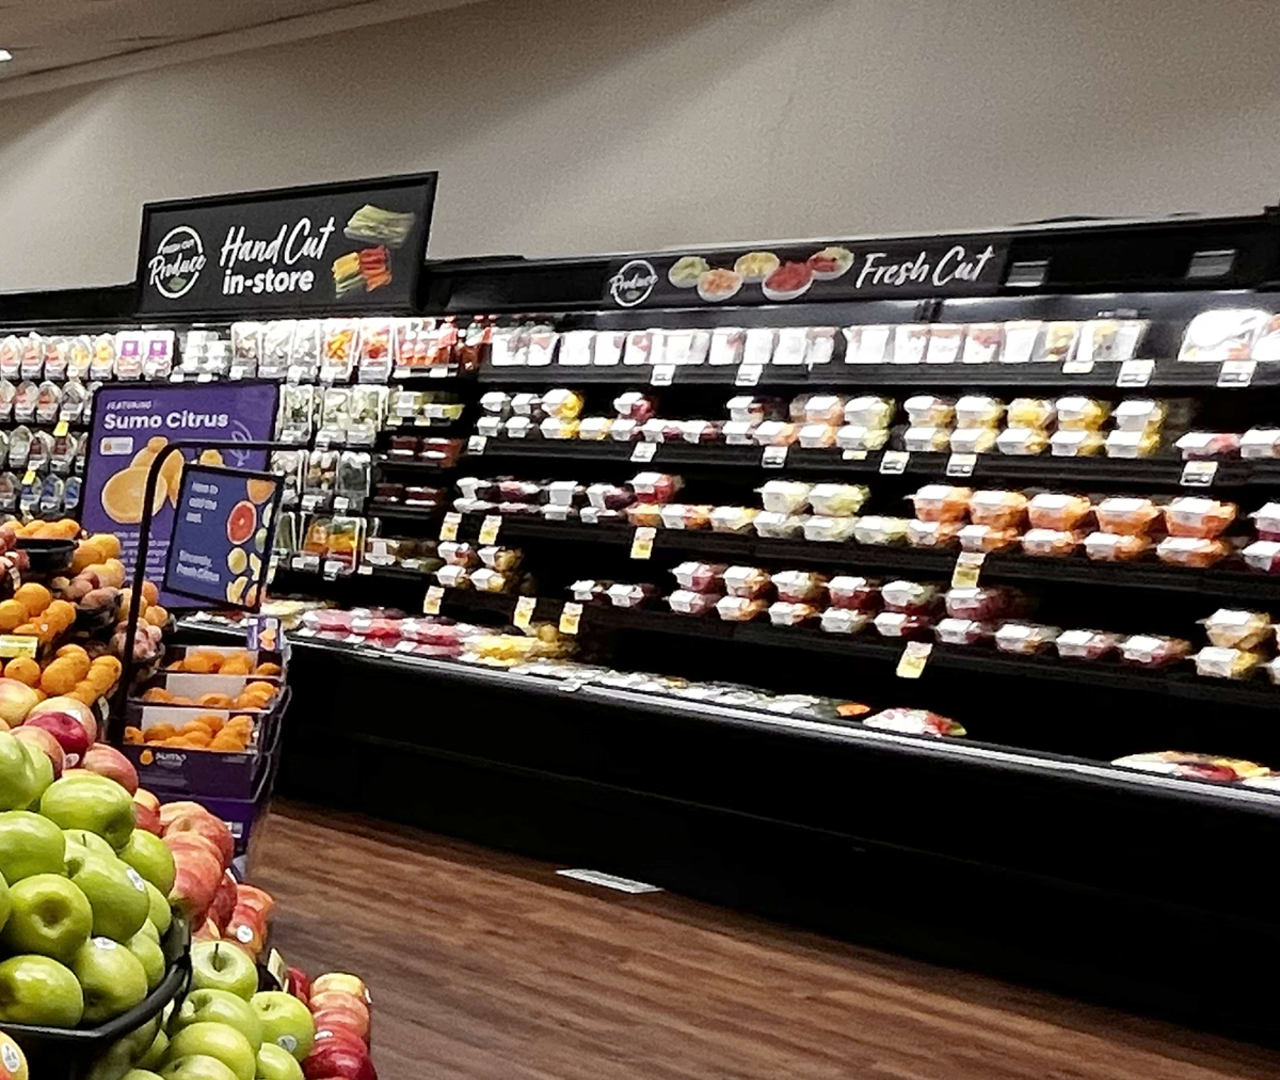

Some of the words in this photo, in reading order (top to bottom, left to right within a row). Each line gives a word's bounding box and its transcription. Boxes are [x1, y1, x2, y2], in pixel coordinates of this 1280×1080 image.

[219, 224, 288, 267] Hand
[285, 216, 336, 265] Cut
[147, 253, 207, 285] Produce
[222, 268, 315, 295] in-store
[855, 250, 930, 289] Fresh
[932, 245, 996, 287] Cut
[103, 413, 163, 430] Sumo
[165, 410, 229, 428] Citrus
